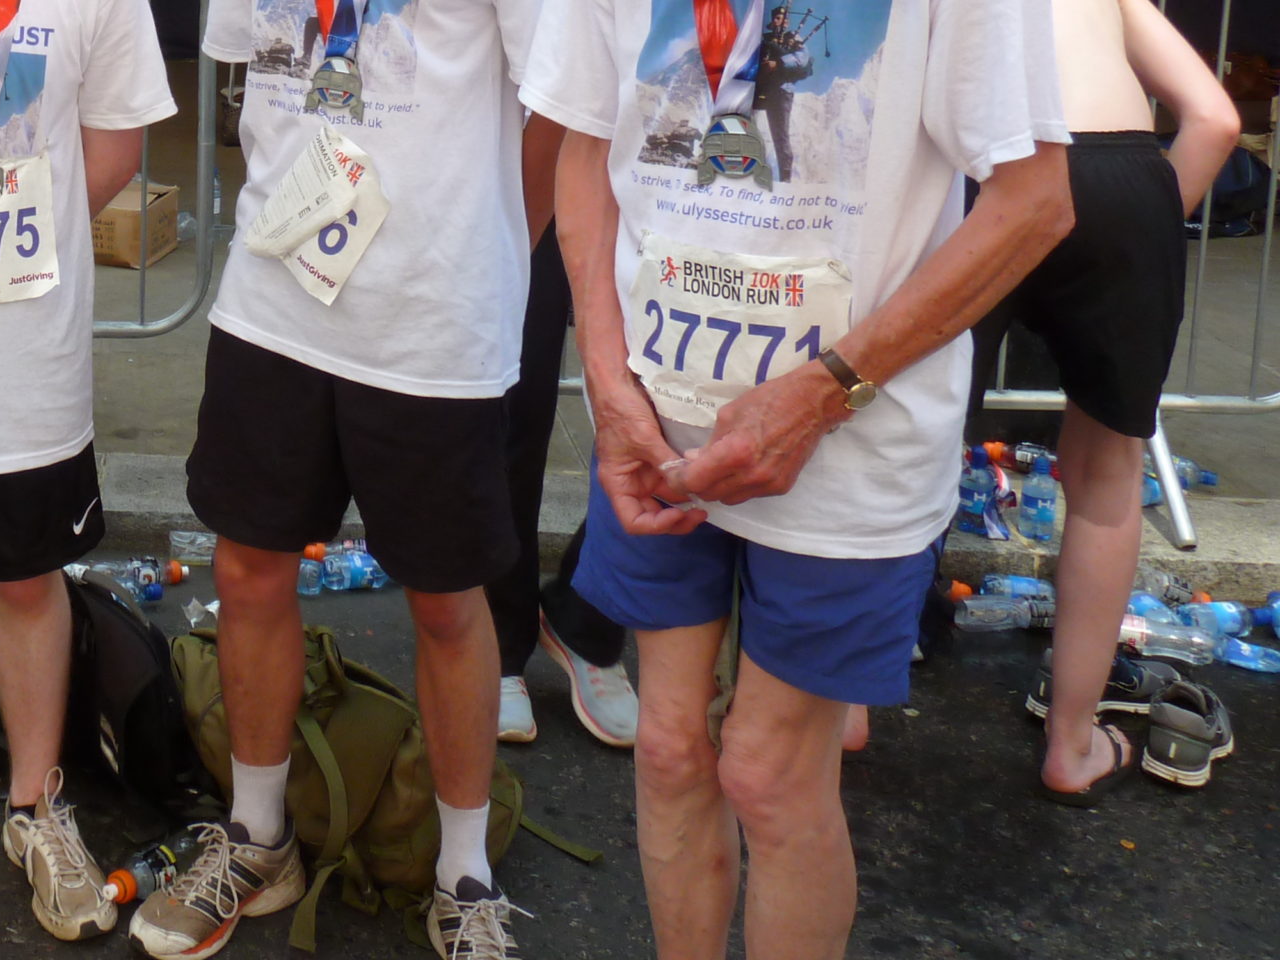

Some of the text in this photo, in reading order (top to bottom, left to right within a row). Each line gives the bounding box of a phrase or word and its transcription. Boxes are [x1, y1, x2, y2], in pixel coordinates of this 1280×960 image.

[720, 185, 733, 199] To
[770, 194, 795, 208] and
[798, 196, 821, 207] not
[824, 195, 838, 208] to
[9, 271, 54, 286] JustGiving
[297, 254, 337, 289] JustGiving
[683, 260, 782, 289] BRITISH 10K
[683, 277, 780, 305] LONDON RUN
